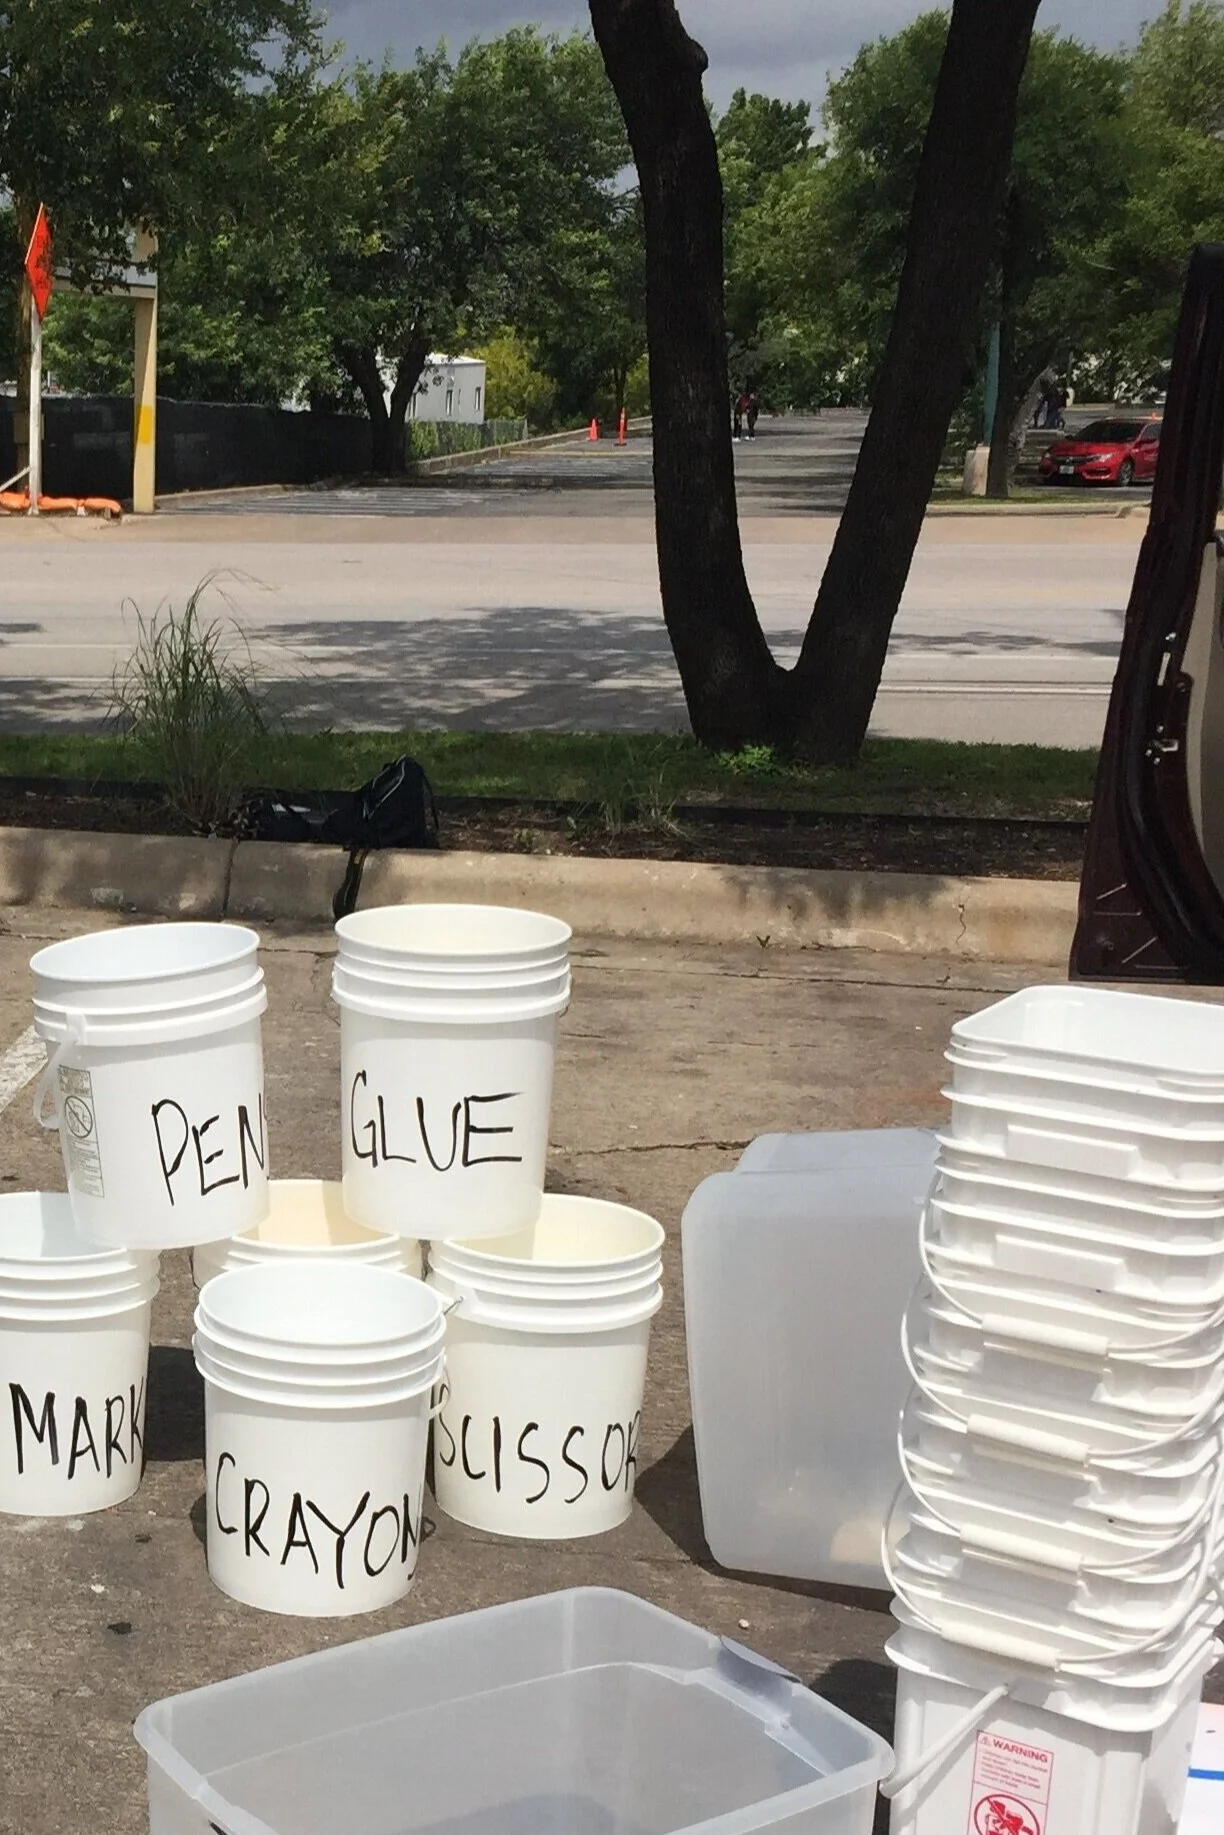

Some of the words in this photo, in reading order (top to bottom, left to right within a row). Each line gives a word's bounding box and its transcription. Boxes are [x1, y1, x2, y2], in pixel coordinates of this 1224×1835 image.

[151, 1092, 269, 1206] PEN
[350, 1068, 524, 1173] GLUE
[8, 1376, 144, 1480] MARK
[215, 1451, 421, 1589] CRAYON
[993, 1738, 1049, 1764] WARNING
